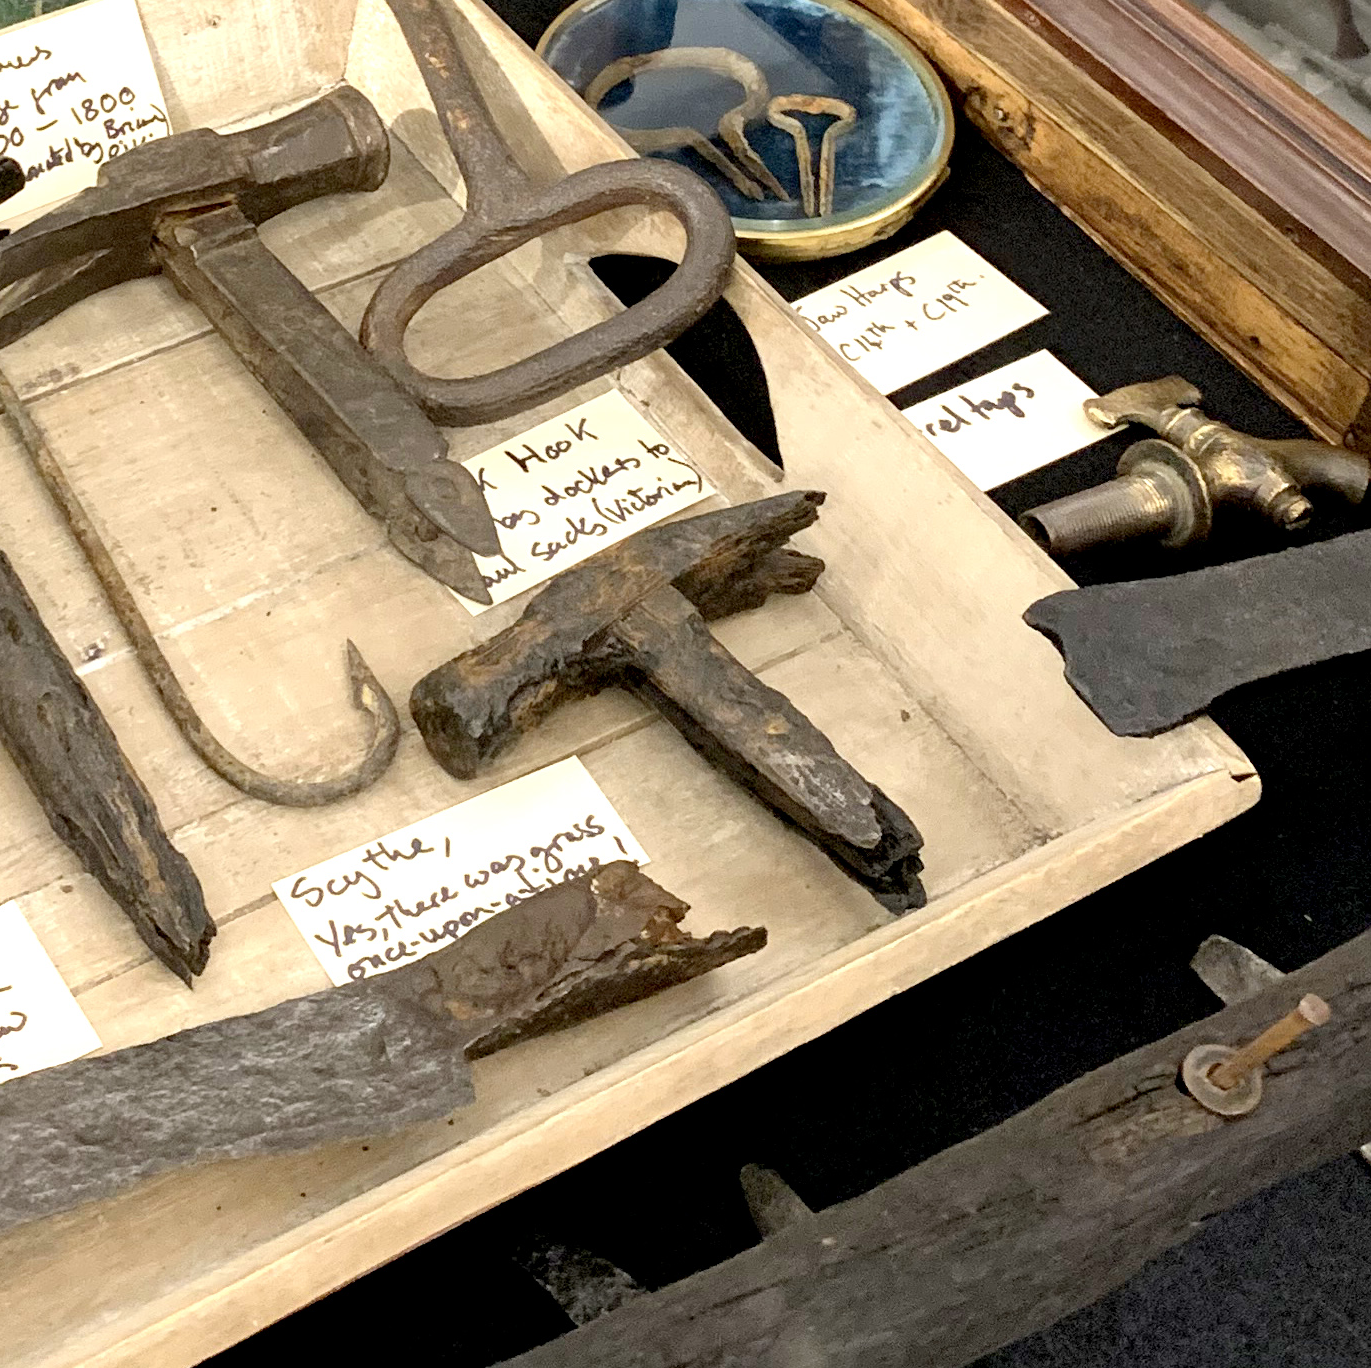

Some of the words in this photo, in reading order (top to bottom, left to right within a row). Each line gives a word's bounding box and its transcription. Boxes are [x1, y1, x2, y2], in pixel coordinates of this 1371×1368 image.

[31, 71, 88, 116] from
[70, 86, 136, 125] 1800
[839, 270, 917, 308] Harps
[636, 437, 672, 460] to
[482, 553, 528, 590] aul
[530, 515, 609, 563] sacks
[374, 885, 460, 930] there
